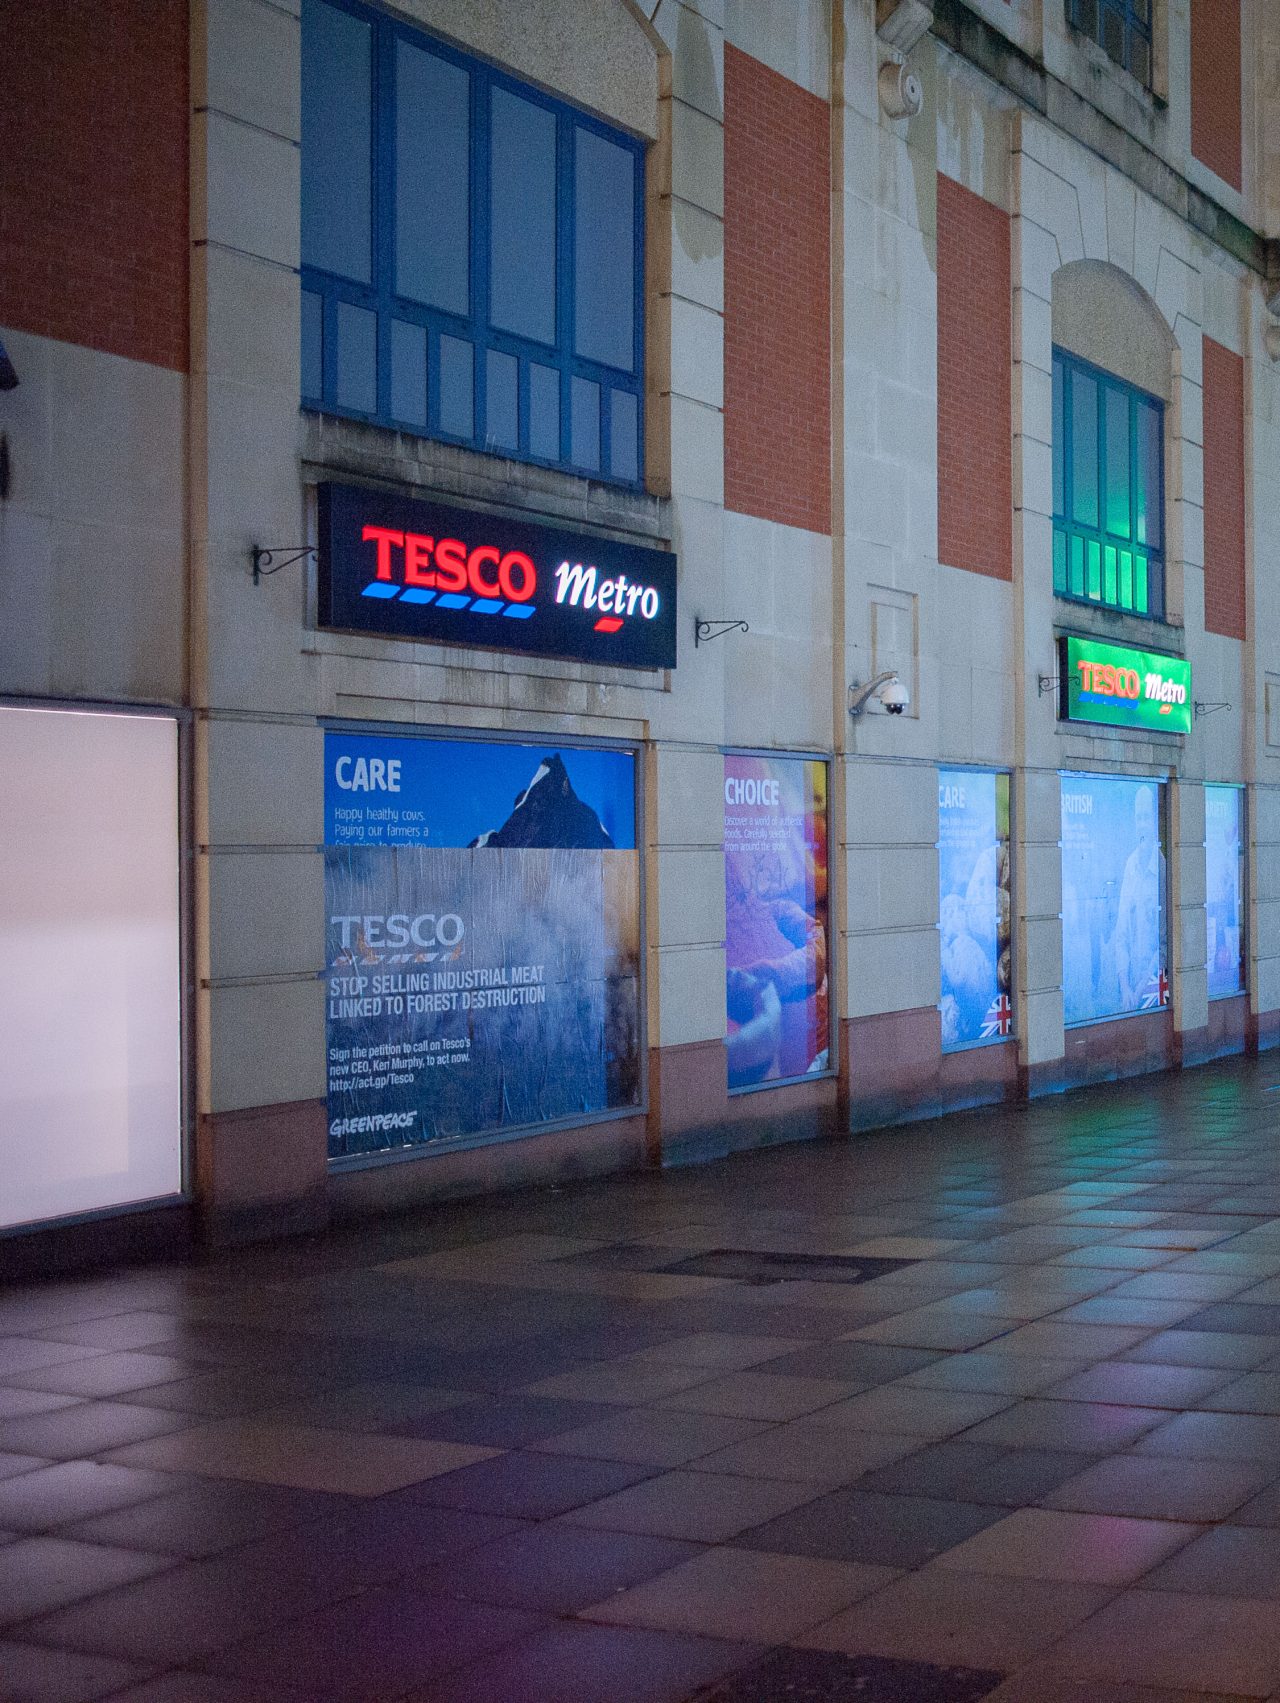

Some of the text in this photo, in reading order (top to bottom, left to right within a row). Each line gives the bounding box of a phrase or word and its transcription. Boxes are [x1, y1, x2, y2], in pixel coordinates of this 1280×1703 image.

[362, 524, 659, 619] TESCO Metro
[1078, 660, 1185, 704] TESCO Metro
[335, 756, 402, 793] CARE
[725, 777, 780, 806] CHOICE
[938, 785, 966, 809] CARE
[334, 807, 363, 822] Happy
[366, 806, 399, 822] healthy
[335, 823, 429, 840] Paying our farmers a
[331, 913, 466, 949] TESCO
[330, 965, 545, 997] STOP SELLING INDUSTRIAL MEAT
[330, 986, 546, 1019] LINKED TO FOREST DESTRUCTION
[329, 1048, 350, 1062] Sign
[352, 1046, 367, 1059] the
[368, 1043, 401, 1061] petition
[403, 1043, 412, 1054] to
[413, 1041, 429, 1053] call
[430, 1042, 441, 1051] on
[329, 1064, 351, 1077] new
[352, 1060, 372, 1076] CEO,
[373, 1058, 390, 1072] Ken
[392, 1055, 425, 1073] Murphy,
[435, 1054, 450, 1066] act
[329, 1072, 415, 1094] http://act.gp/Tesco
[329, 1110, 418, 1138] GREENPEACE
